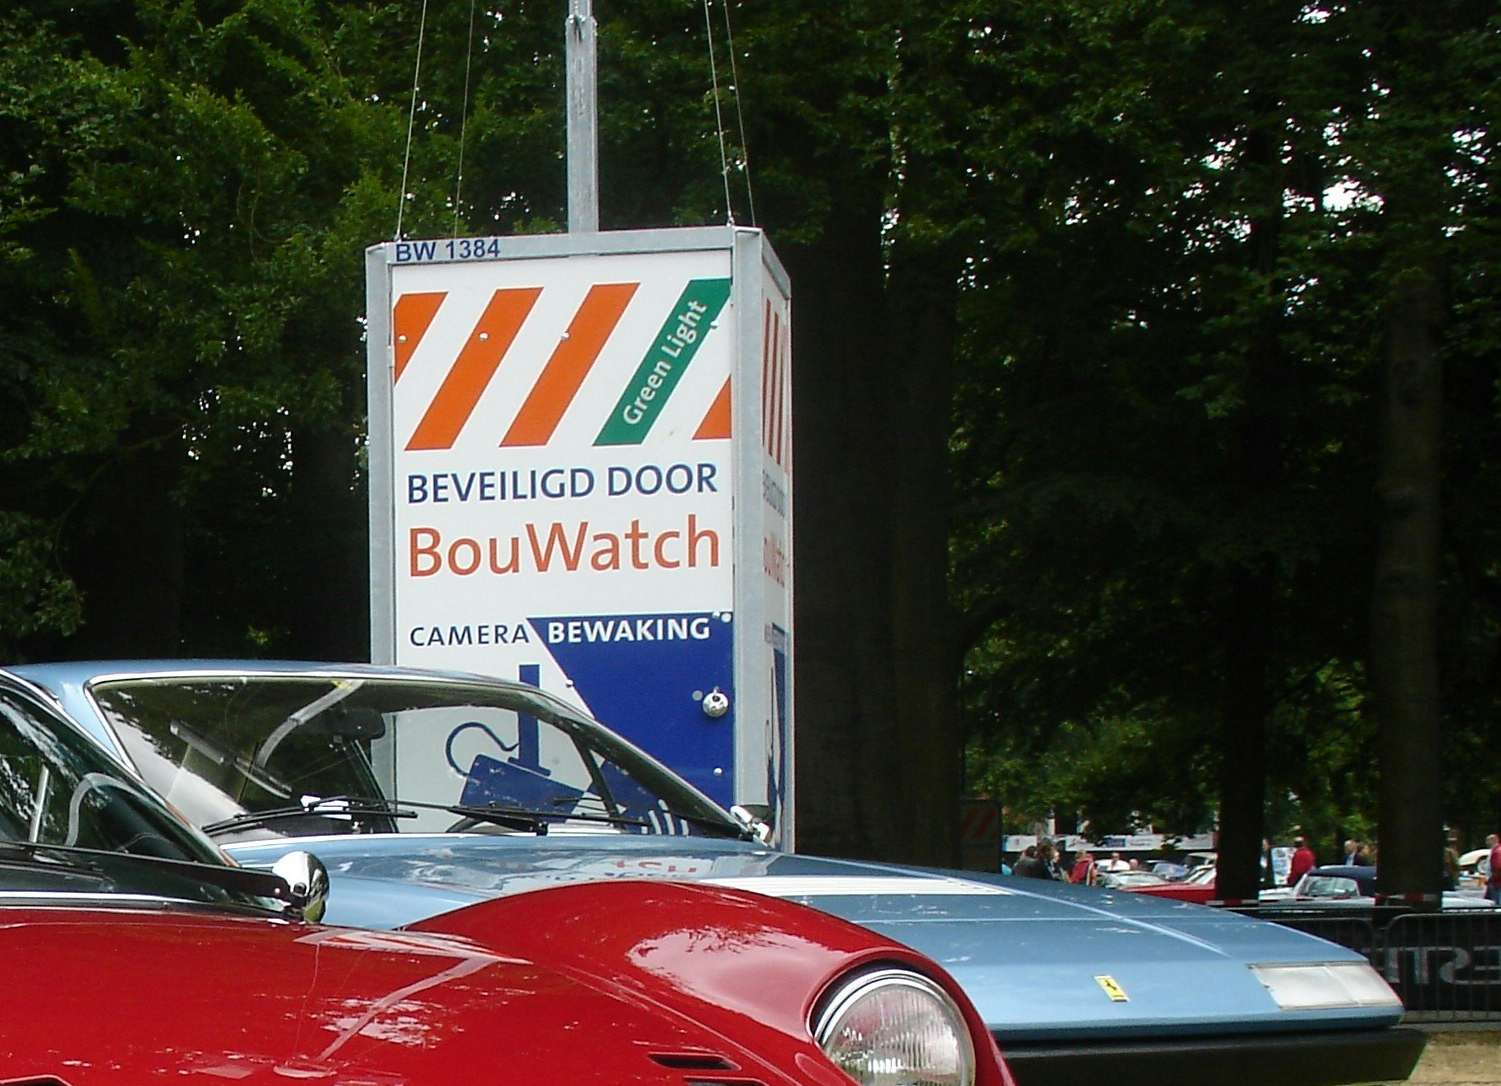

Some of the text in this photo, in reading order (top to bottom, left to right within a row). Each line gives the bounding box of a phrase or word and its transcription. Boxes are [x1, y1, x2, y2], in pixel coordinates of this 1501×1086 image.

[396, 239, 501, 262] BW 1384
[622, 300, 707, 425] Green Light
[407, 463, 718, 504] BEVEILIGD DOOR
[409, 514, 720, 577] BouWatch
[409, 617, 711, 647] CAMERA BEWAKING
